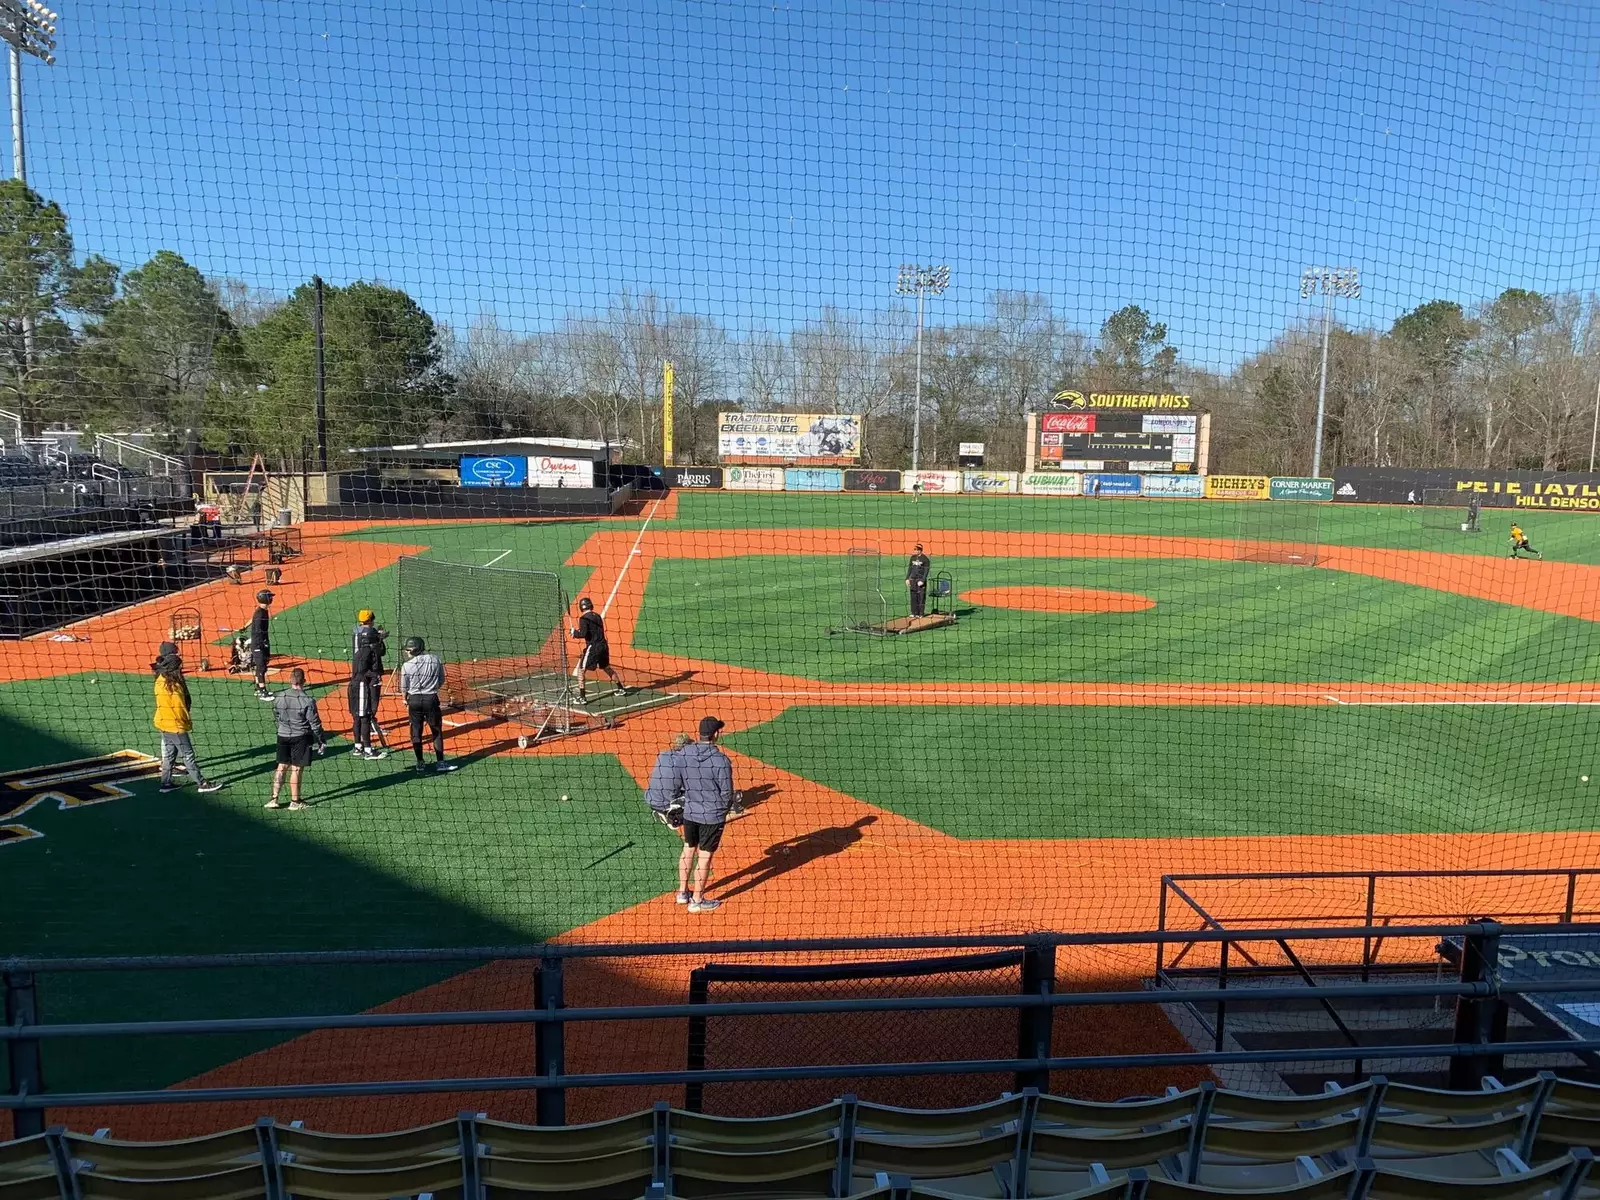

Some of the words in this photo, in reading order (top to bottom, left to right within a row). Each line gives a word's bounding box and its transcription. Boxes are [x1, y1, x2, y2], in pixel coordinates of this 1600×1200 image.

[1089, 393, 1157, 407] SOUTHERN
[1159, 394, 1190, 408] MISS
[725, 414, 778, 422] TRADITION
[780, 415, 796, 423] OF
[721, 424, 799, 433] EXCELLENCE
[541, 458, 577, 471] Owens
[677, 468, 711, 487] PARRIS
[1025, 475, 1075, 486] SUBWAY
[1534, 483, 1600, 496] TAYL
[1516, 495, 1547, 507] HILL
